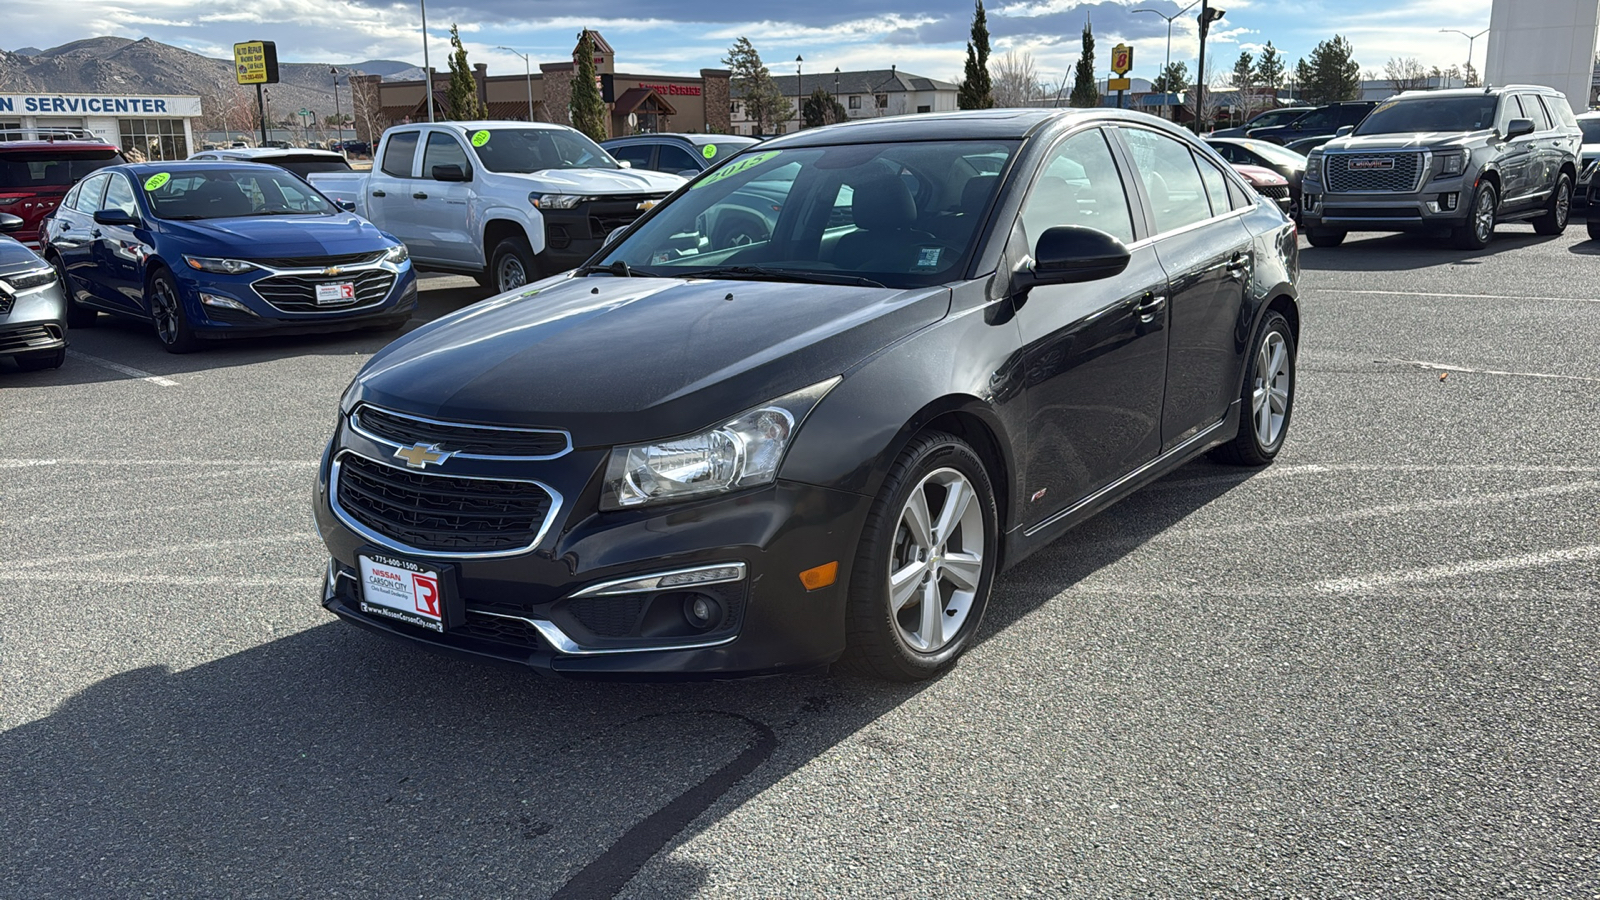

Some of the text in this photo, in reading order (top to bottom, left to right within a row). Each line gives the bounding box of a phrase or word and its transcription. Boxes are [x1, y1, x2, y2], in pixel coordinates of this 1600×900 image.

[247, 45, 262, 54] REPAIR
[1116, 53, 1128, 68] 8
[669, 83, 701, 96] STRIKE
[25, 97, 167, 113] SERVICENTER
[706, 153, 766, 185] 2015
[1350, 160, 1392, 168] GMC
[147, 174, 166, 189] 2023
[375, 555, 418, 571] 775-600-1500
[372, 568, 401, 581] NISSAN
[369, 576, 408, 591] CARSON CITY
[391, 591, 409, 600] Dealership
[415, 578, 438, 615] R
[367, 607, 437, 630] www.NissanCarsonCity.com
